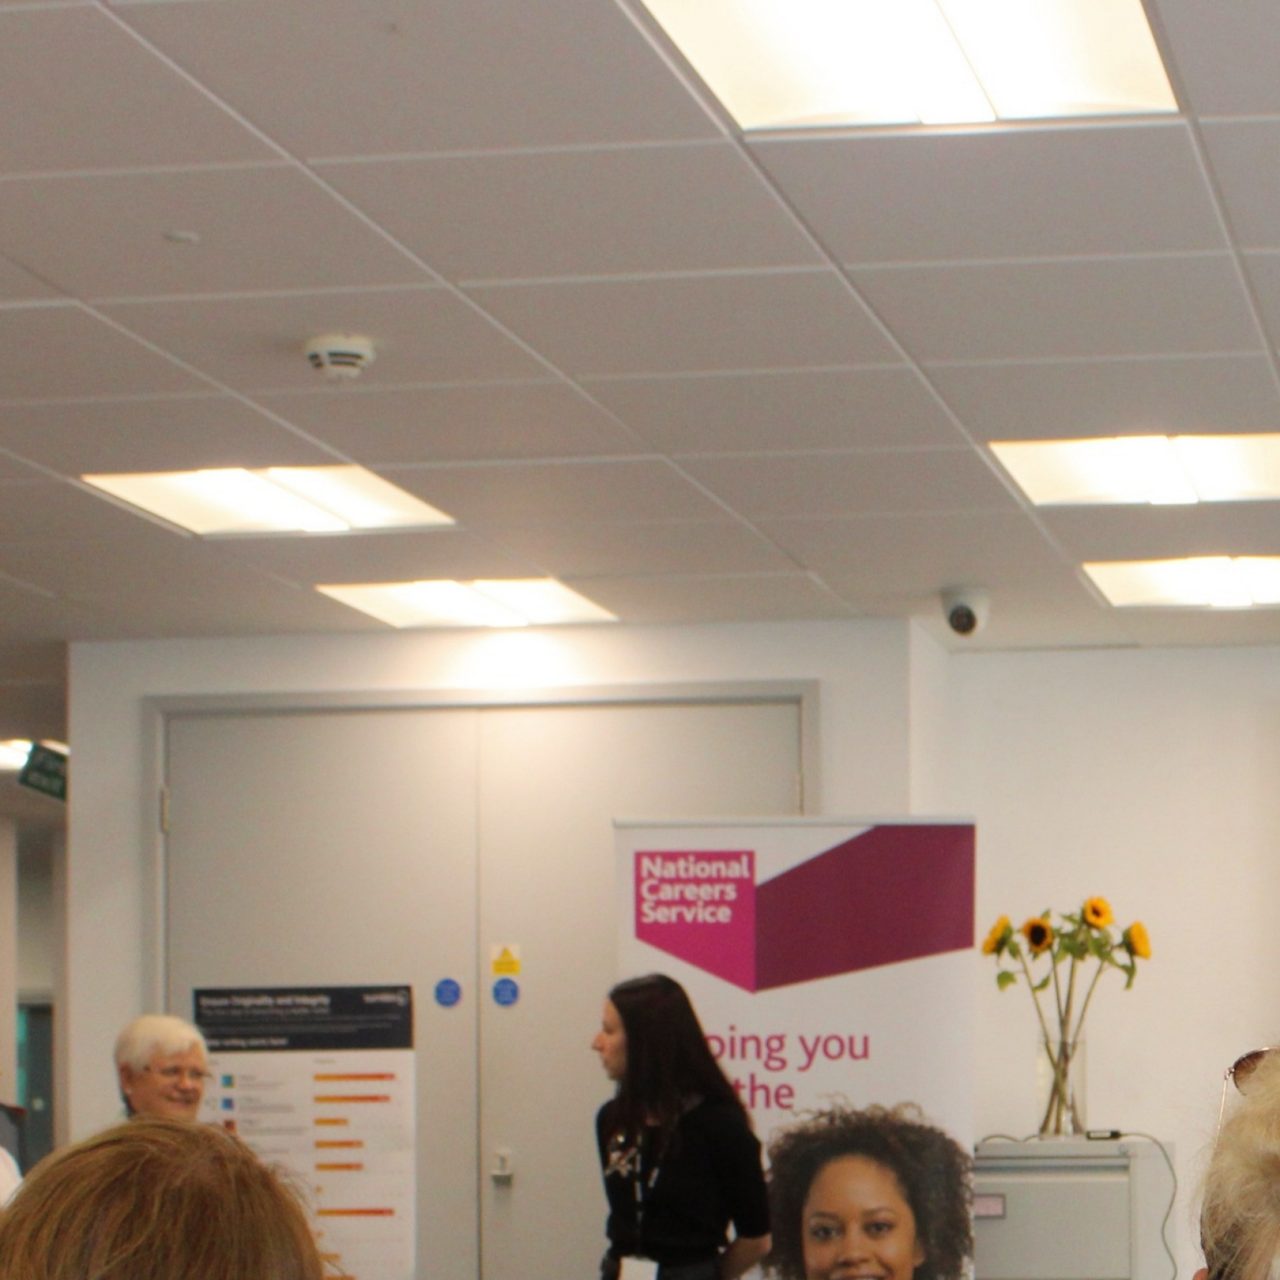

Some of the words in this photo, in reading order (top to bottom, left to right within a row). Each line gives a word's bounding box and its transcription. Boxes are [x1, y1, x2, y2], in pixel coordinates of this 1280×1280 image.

[640, 855, 750, 879] National
[640, 879, 737, 901] Careers
[640, 901, 732, 924] Service
[703, 1025, 788, 1072] ping
[796, 1033, 871, 1072] you
